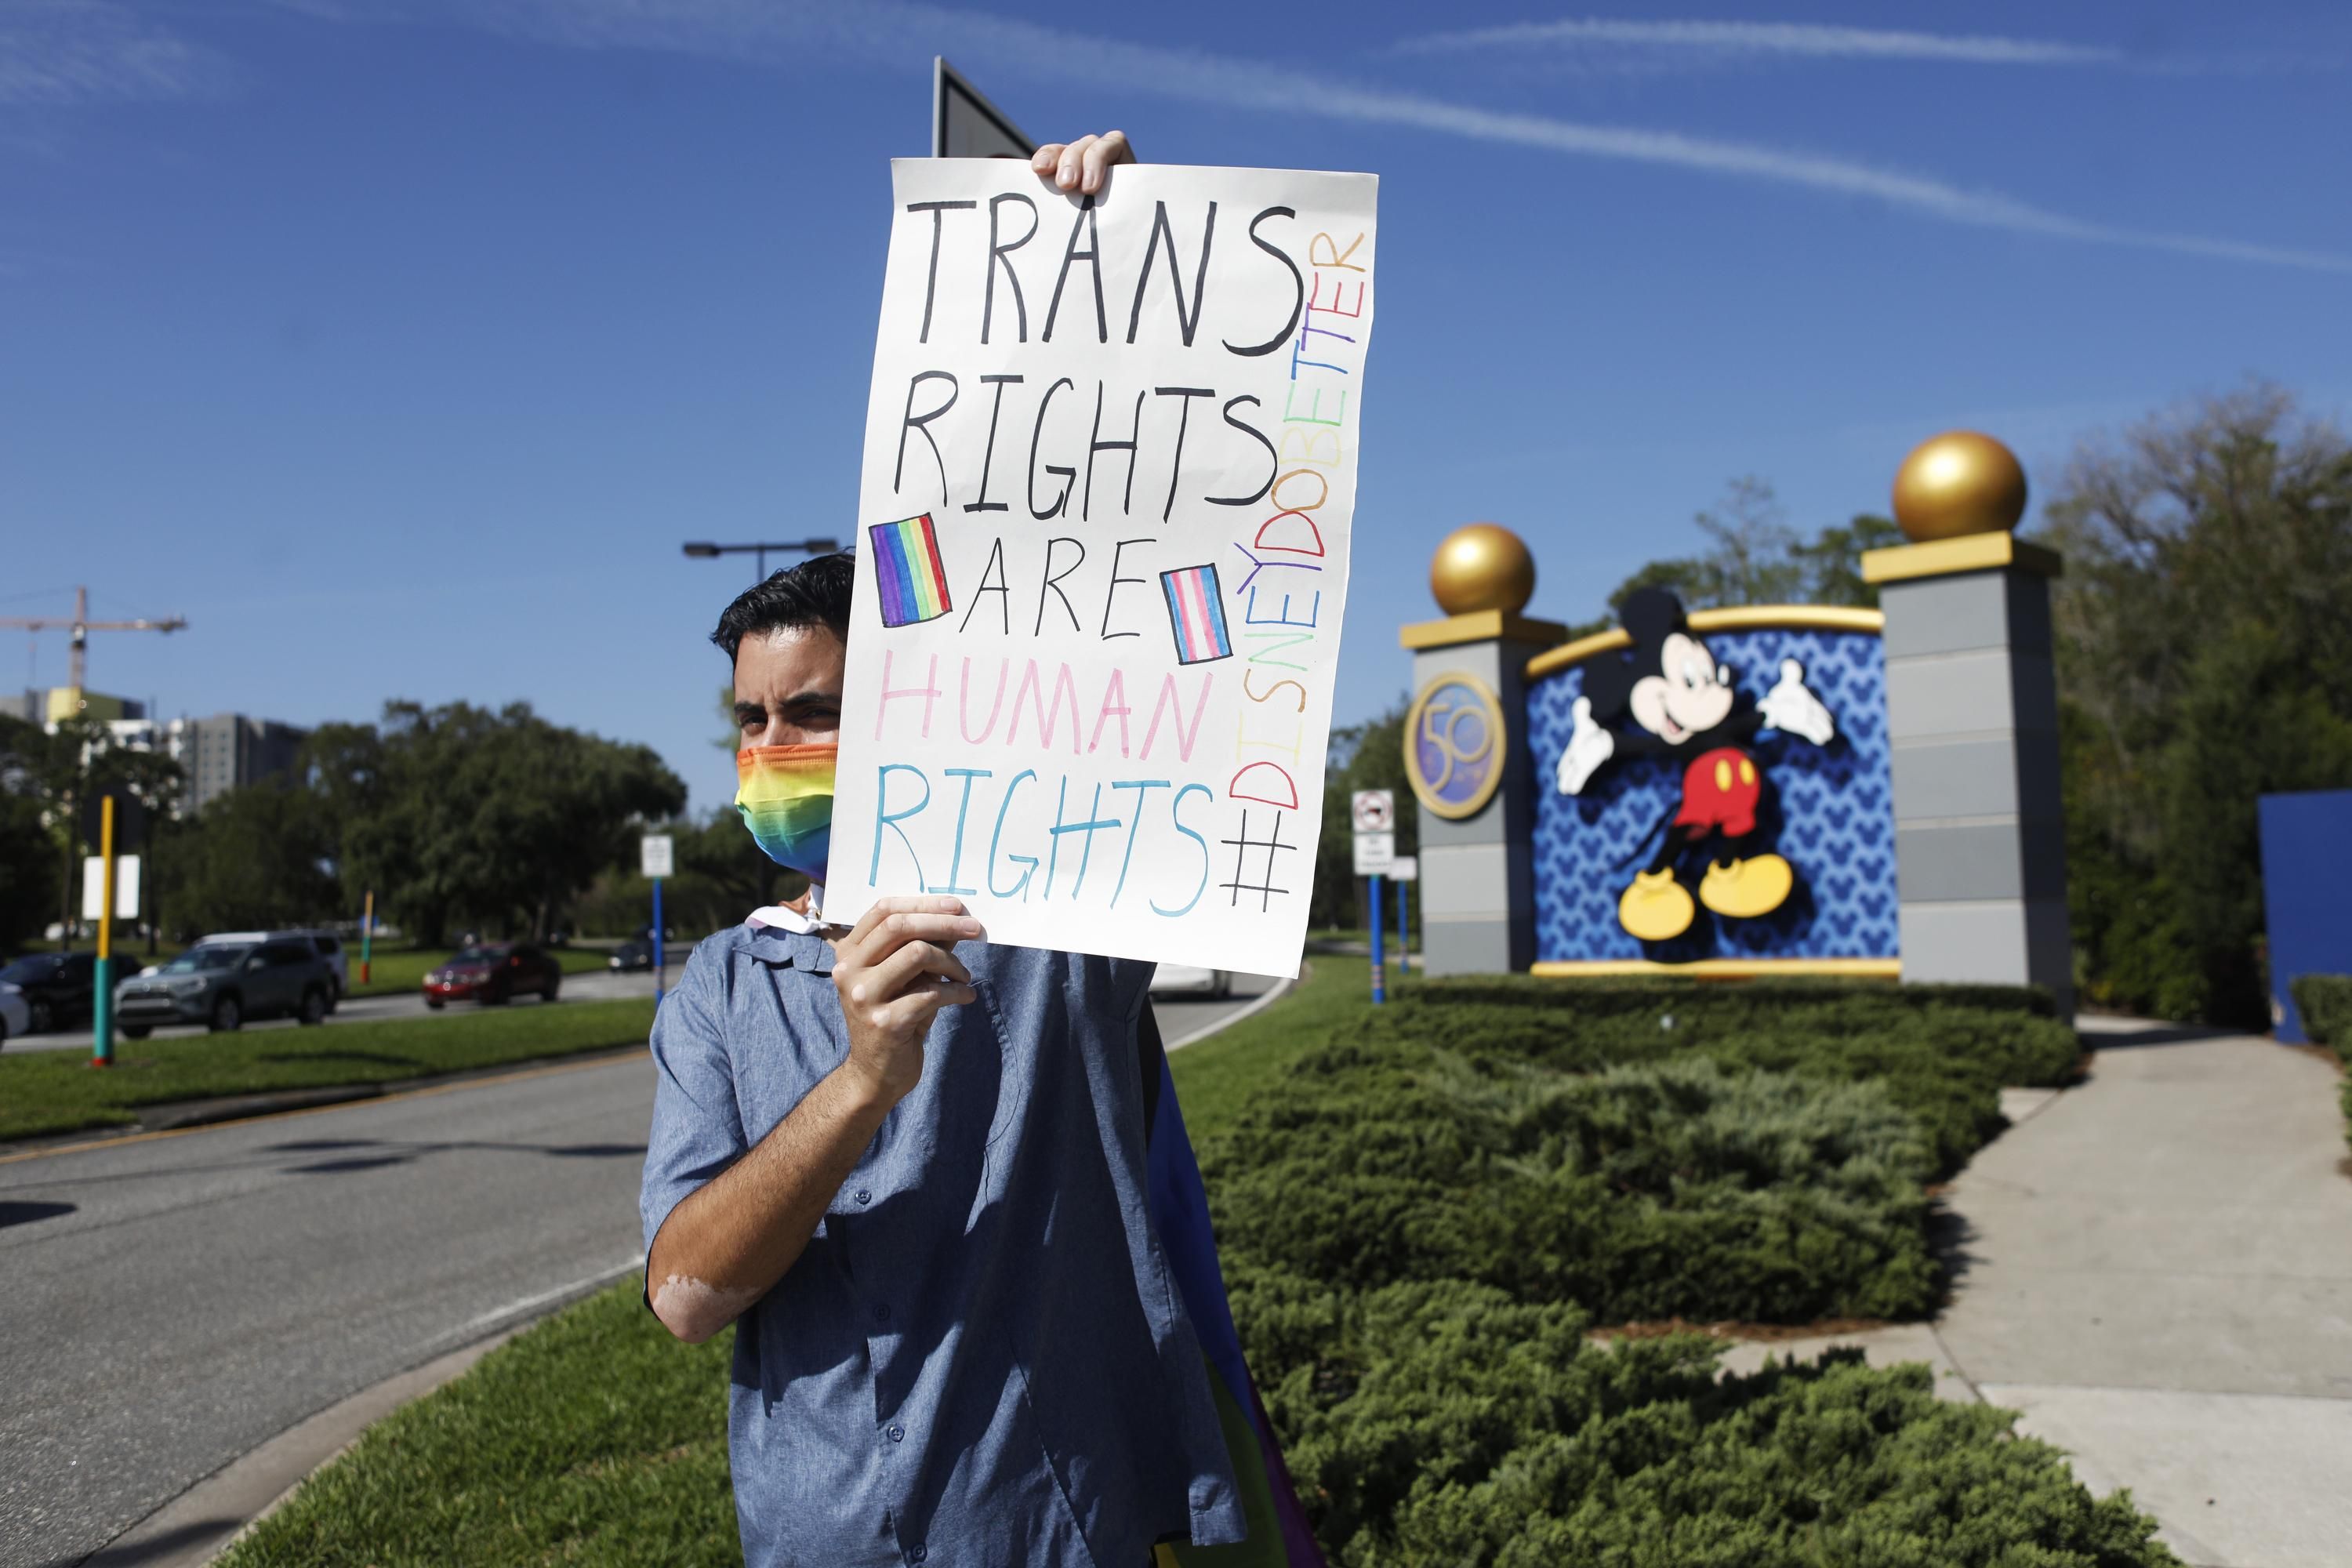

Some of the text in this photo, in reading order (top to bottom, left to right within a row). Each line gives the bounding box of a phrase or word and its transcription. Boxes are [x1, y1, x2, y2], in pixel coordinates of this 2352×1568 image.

[907, 193, 1304, 357] TRANS
[895, 370, 1279, 524] RIGHTS
[959, 537, 1157, 641] ARE
[875, 649, 1214, 762] HUMAN
[1424, 703, 1494, 793] 50
[869, 764, 1214, 917] RIGHTS
